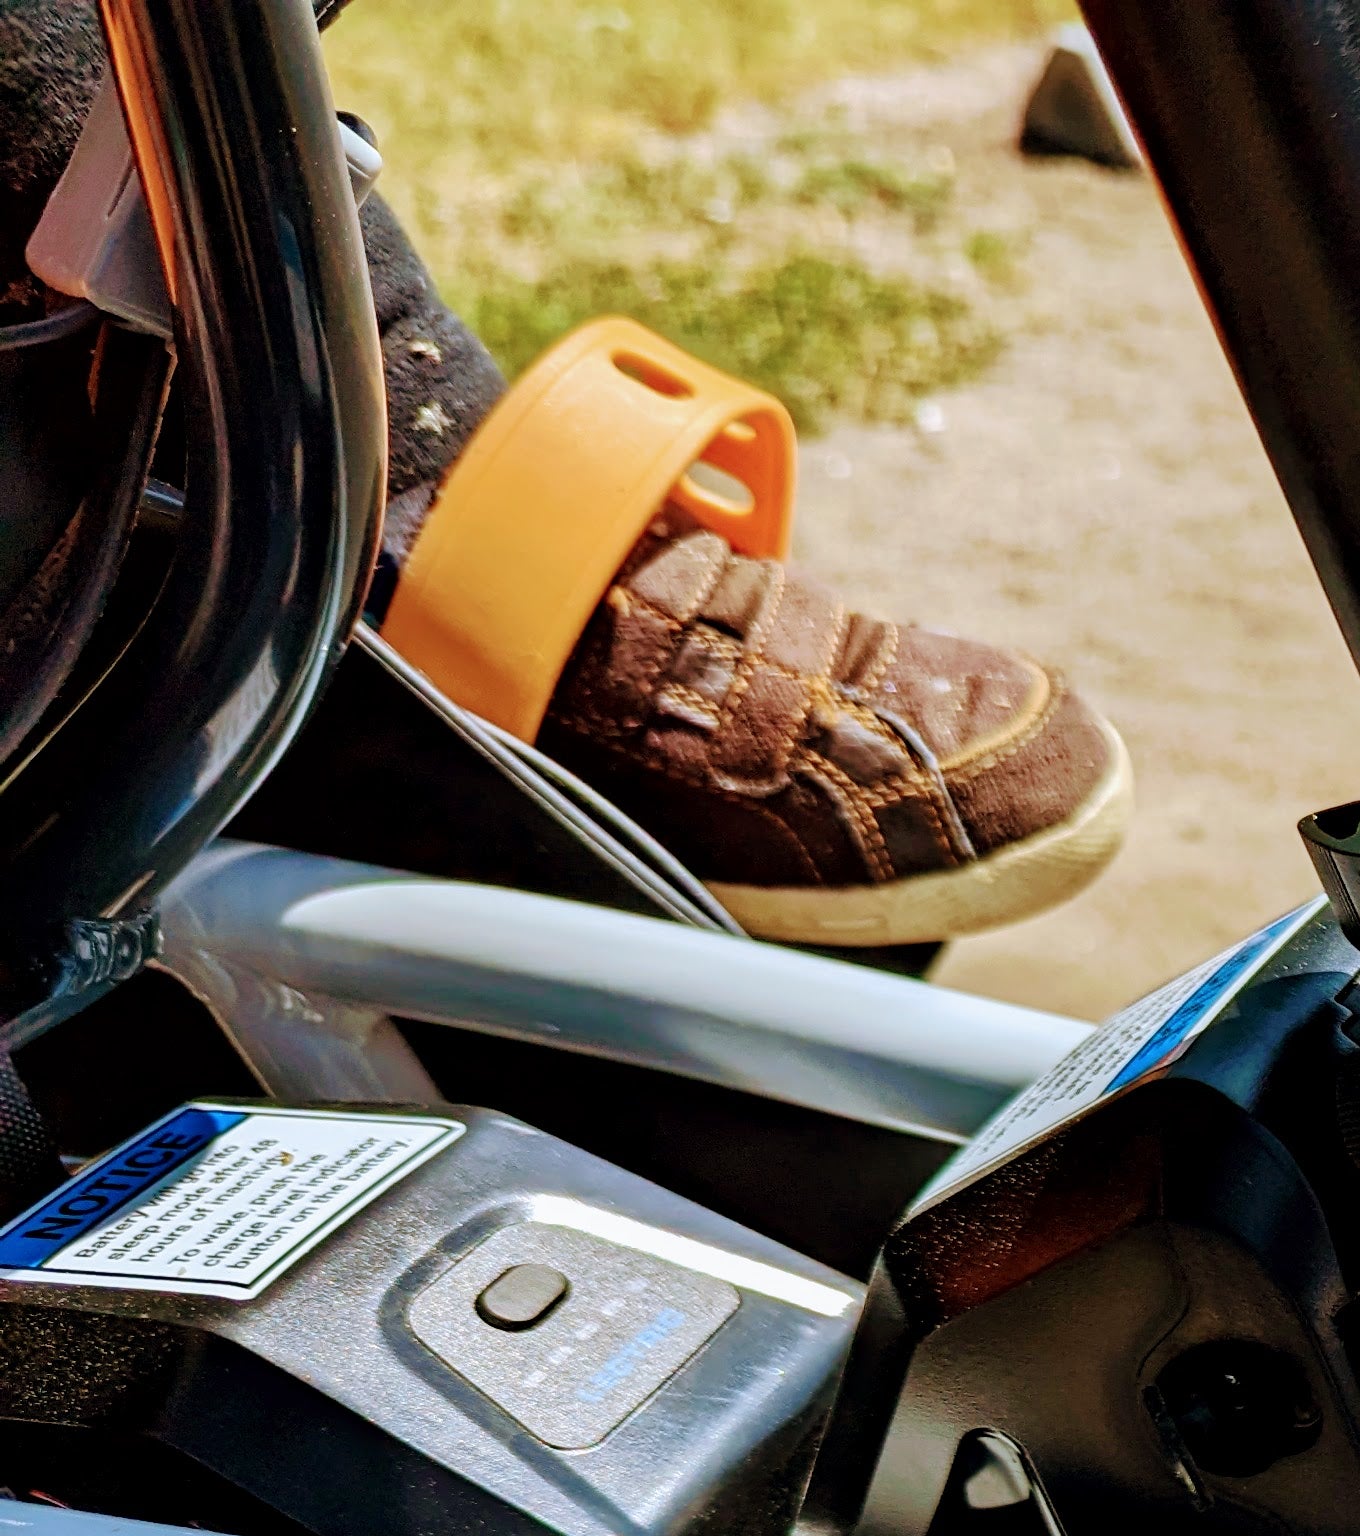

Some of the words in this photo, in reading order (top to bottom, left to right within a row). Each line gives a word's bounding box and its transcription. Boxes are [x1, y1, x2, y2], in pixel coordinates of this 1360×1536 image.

[21, 1132, 203, 1241] NOTICE
[74, 1210, 149, 1258] Battery
[149, 1185, 181, 1207] will
[200, 1145, 239, 1166] into
[107, 1225, 160, 1260] sleep
[157, 1186, 213, 1222] mode
[209, 1156, 253, 1184] after
[251, 1139, 280, 1154] 48
[130, 1224, 193, 1263] hours
[189, 1207, 214, 1222] of
[167, 1249, 200, 1265] To
[197, 1209, 257, 1246] wake,
[251, 1175, 298, 1206] push
[291, 1154, 328, 1174] the
[203, 1221, 268, 1267] charge
[258, 1190, 310, 1218] level
[300, 1137, 380, 1187] indicator
[226, 1225, 294, 1269] button
[289, 1206, 319, 1223] on
[310, 1183, 349, 1203] the
[338, 1138, 412, 1182] battery.
